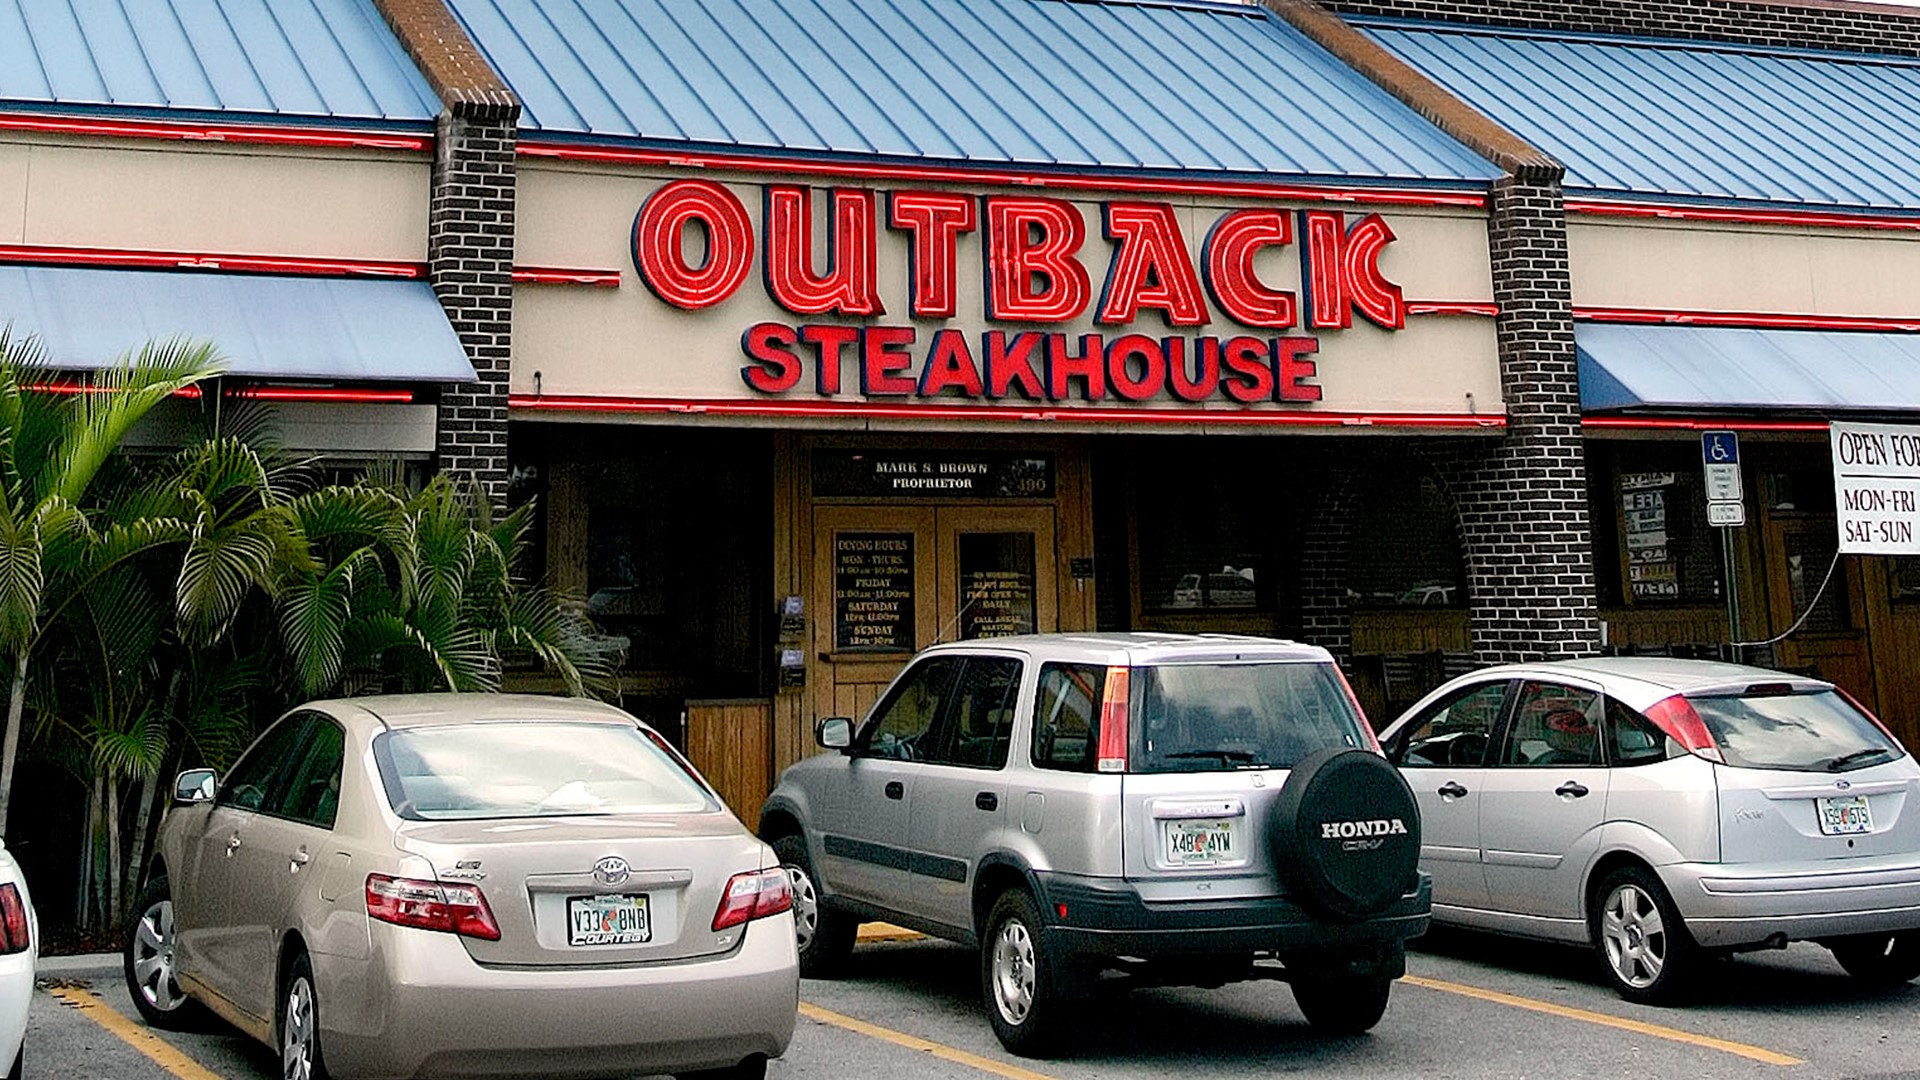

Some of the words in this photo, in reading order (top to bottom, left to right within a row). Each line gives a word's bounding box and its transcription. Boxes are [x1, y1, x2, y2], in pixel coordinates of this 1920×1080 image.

[631, 178, 1405, 330] OUTBACK
[741, 321, 1323, 403] STEAKHOUSE
[1840, 432, 1888, 466] OPEN
[876, 462, 918, 473] MARK
[940, 463, 988, 474] BROWN
[893, 478, 973, 489] PROPRIETOR
[1844, 489, 1916, 512] MON-FRI
[1845, 520, 1912, 542] SAT-SUN
[856, 578, 891, 588] FRIDAY
[848, 601, 899, 612] SATURDAY
[853, 625, 893, 636] SUNDAY
[1321, 819, 1408, 838] HONDA
